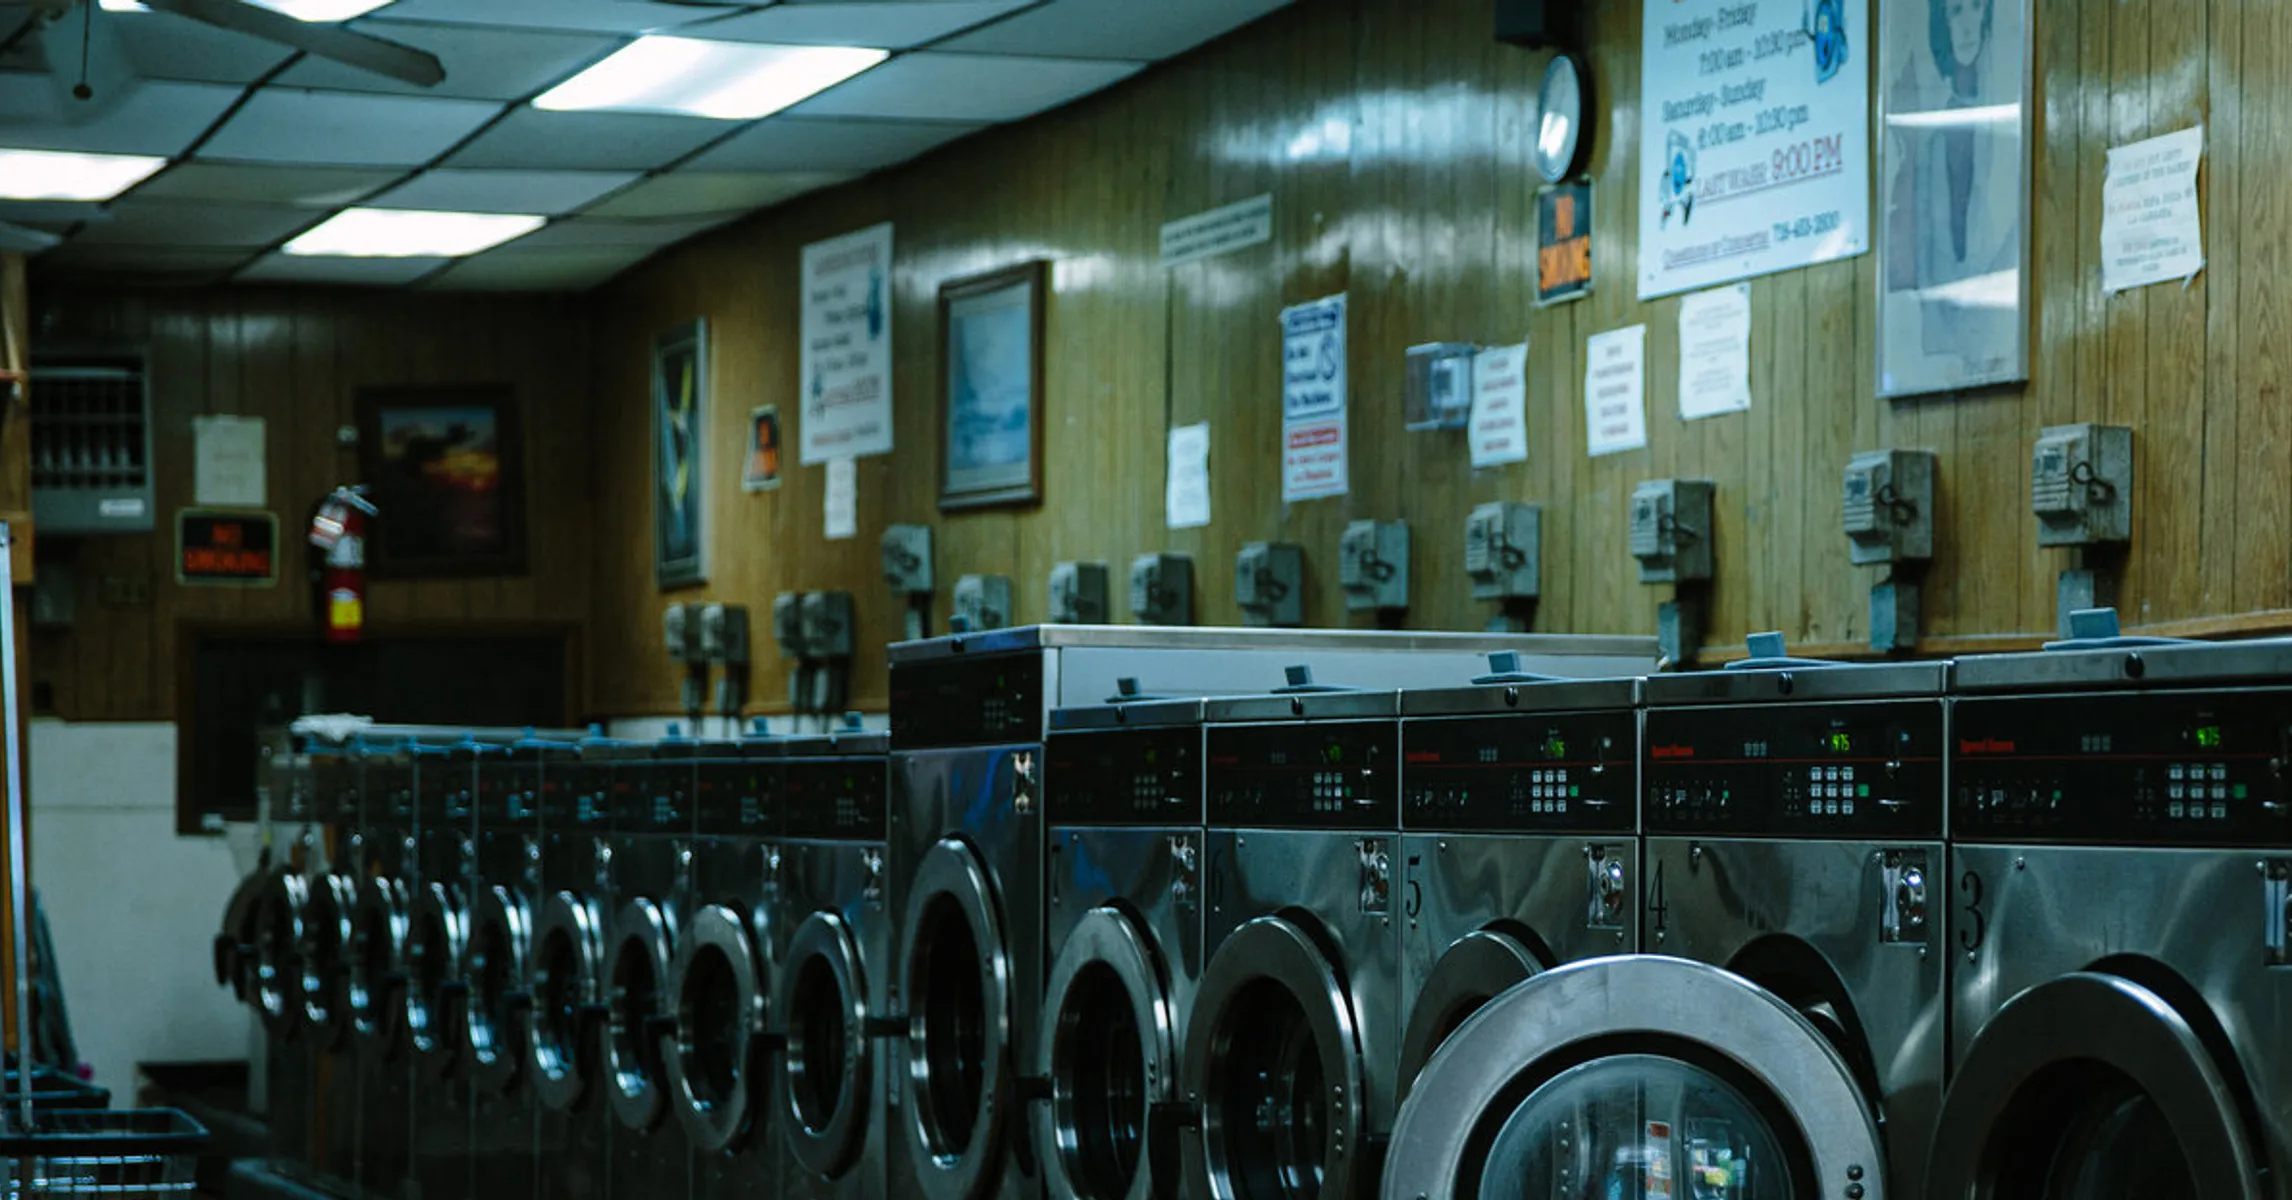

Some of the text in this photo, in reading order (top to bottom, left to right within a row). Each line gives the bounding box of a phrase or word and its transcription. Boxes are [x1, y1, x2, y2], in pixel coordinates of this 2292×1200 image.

[1772, 142, 1811, 181] 9:00
[1814, 132, 1842, 172] PM
[1406, 855, 1422, 918] 5
[1648, 859, 1667, 930] 4
[1960, 871, 1984, 951] 3
